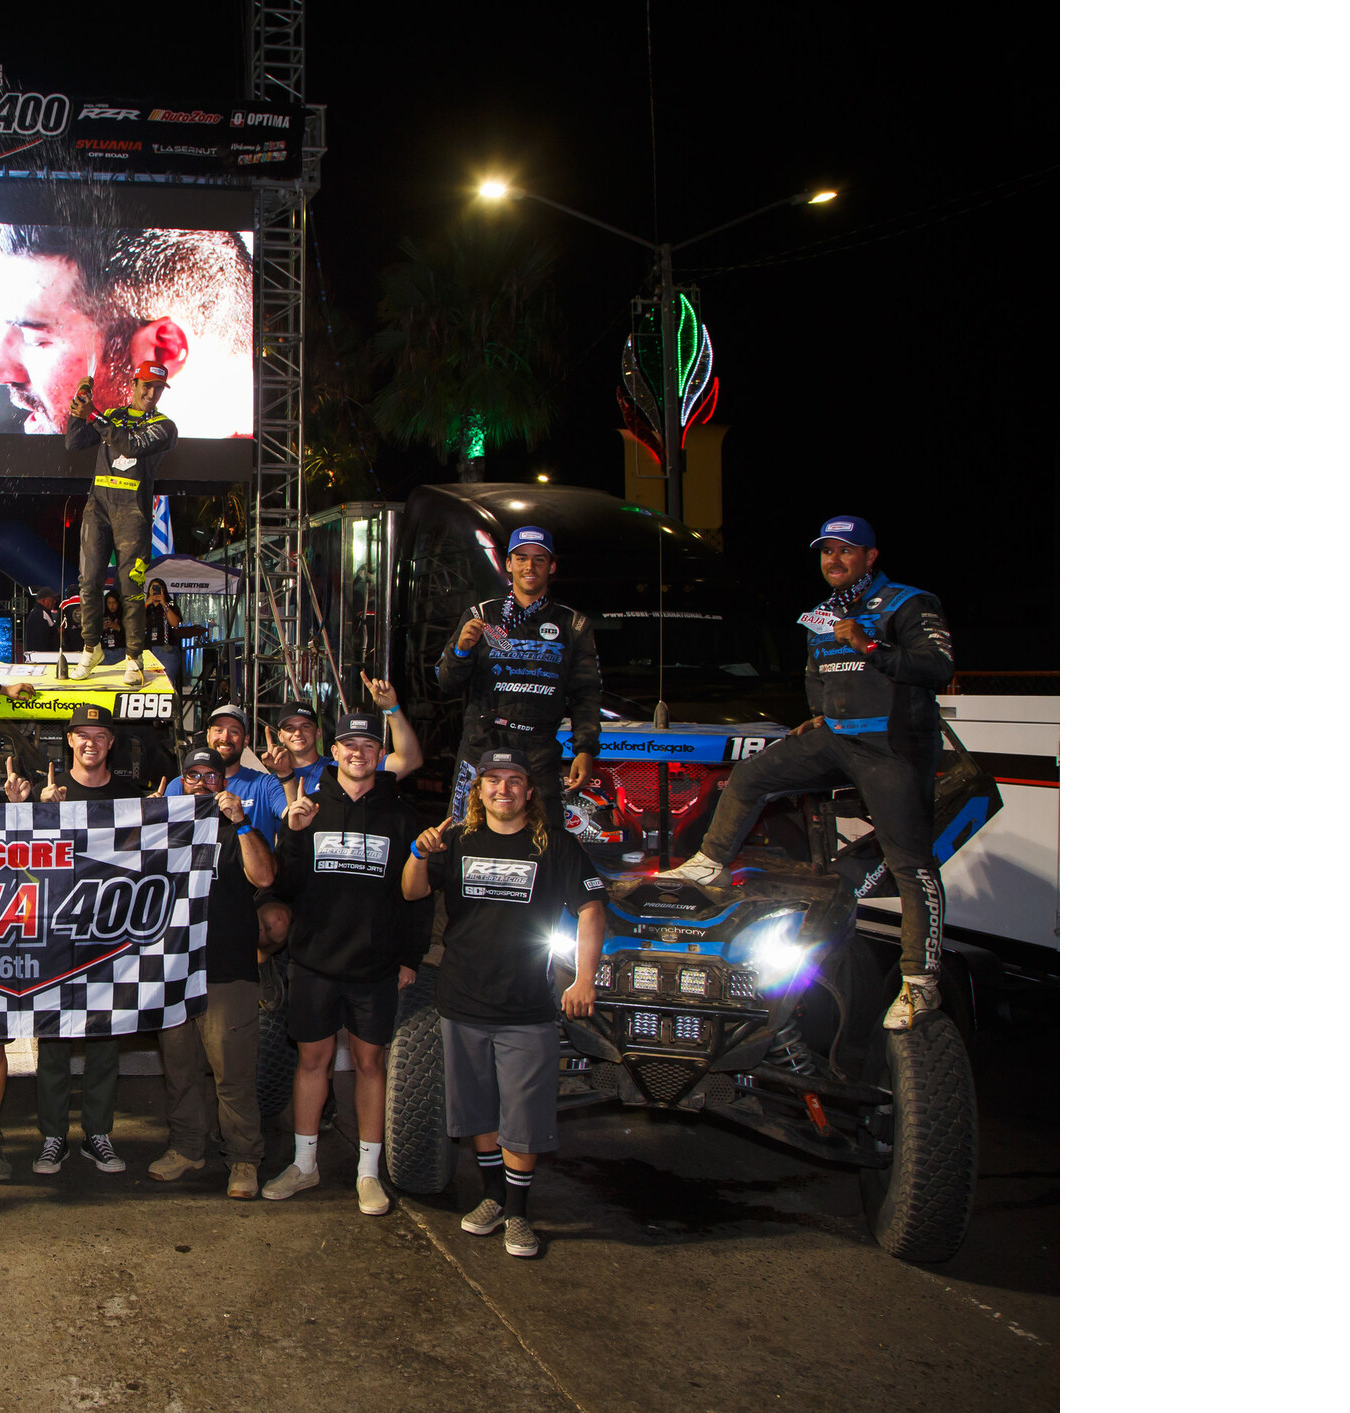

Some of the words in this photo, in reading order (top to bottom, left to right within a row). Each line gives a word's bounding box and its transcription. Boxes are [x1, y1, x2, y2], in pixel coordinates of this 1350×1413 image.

[78, 108, 141, 121] RZR
[160, 110, 222, 124] AutoZone
[247, 113, 290, 128] OPTIMA
[75, 139, 143, 151] SYLVANIA
[800, 614, 826, 626] BAJA
[498, 638, 513, 652] 400
[494, 682, 557, 696] PROGRESSIVE
[120, 694, 173, 718] 1896
[599, 740, 645, 752] ockford
[319, 836, 386, 853] RZR
[466, 861, 532, 877] RZR
[51, 874, 173, 942] 400
[643, 902, 697, 910] PROGRESSIVE
[648, 926, 706, 938] synchrony
